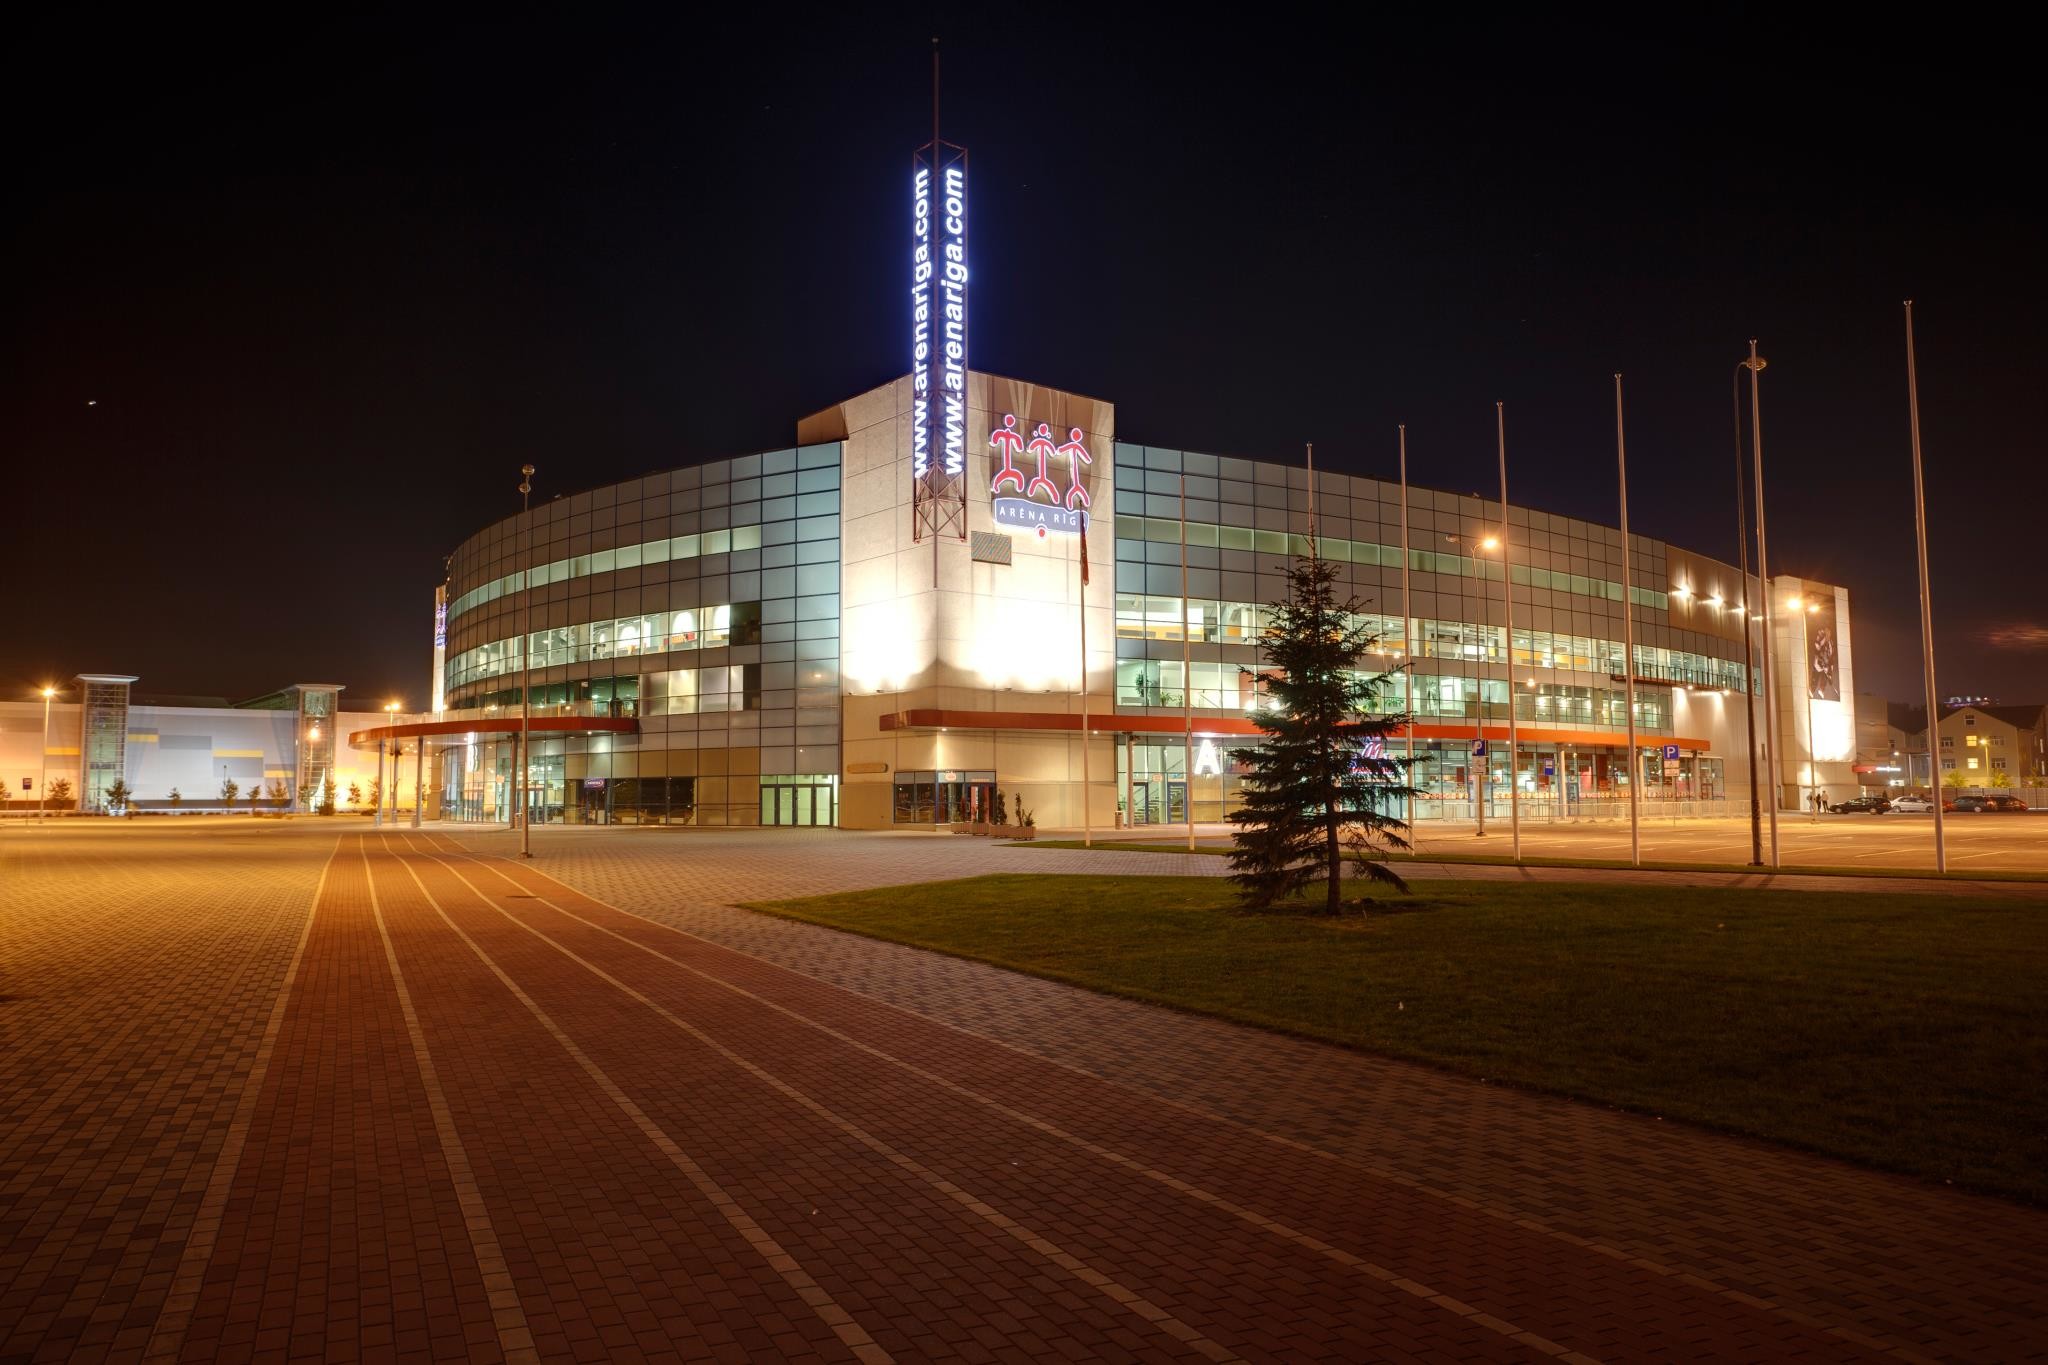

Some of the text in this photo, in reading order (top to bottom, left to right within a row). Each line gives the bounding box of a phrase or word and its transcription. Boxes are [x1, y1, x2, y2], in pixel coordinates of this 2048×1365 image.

[912, 169, 931, 478] www.arenariga.com
[941, 169, 968, 475] www.arenariga.com
[1054, 513, 1083, 527] RĪG
[1194, 739, 1221, 775] A
[1474, 741, 1483, 755] P
[1666, 746, 1676, 758] P
